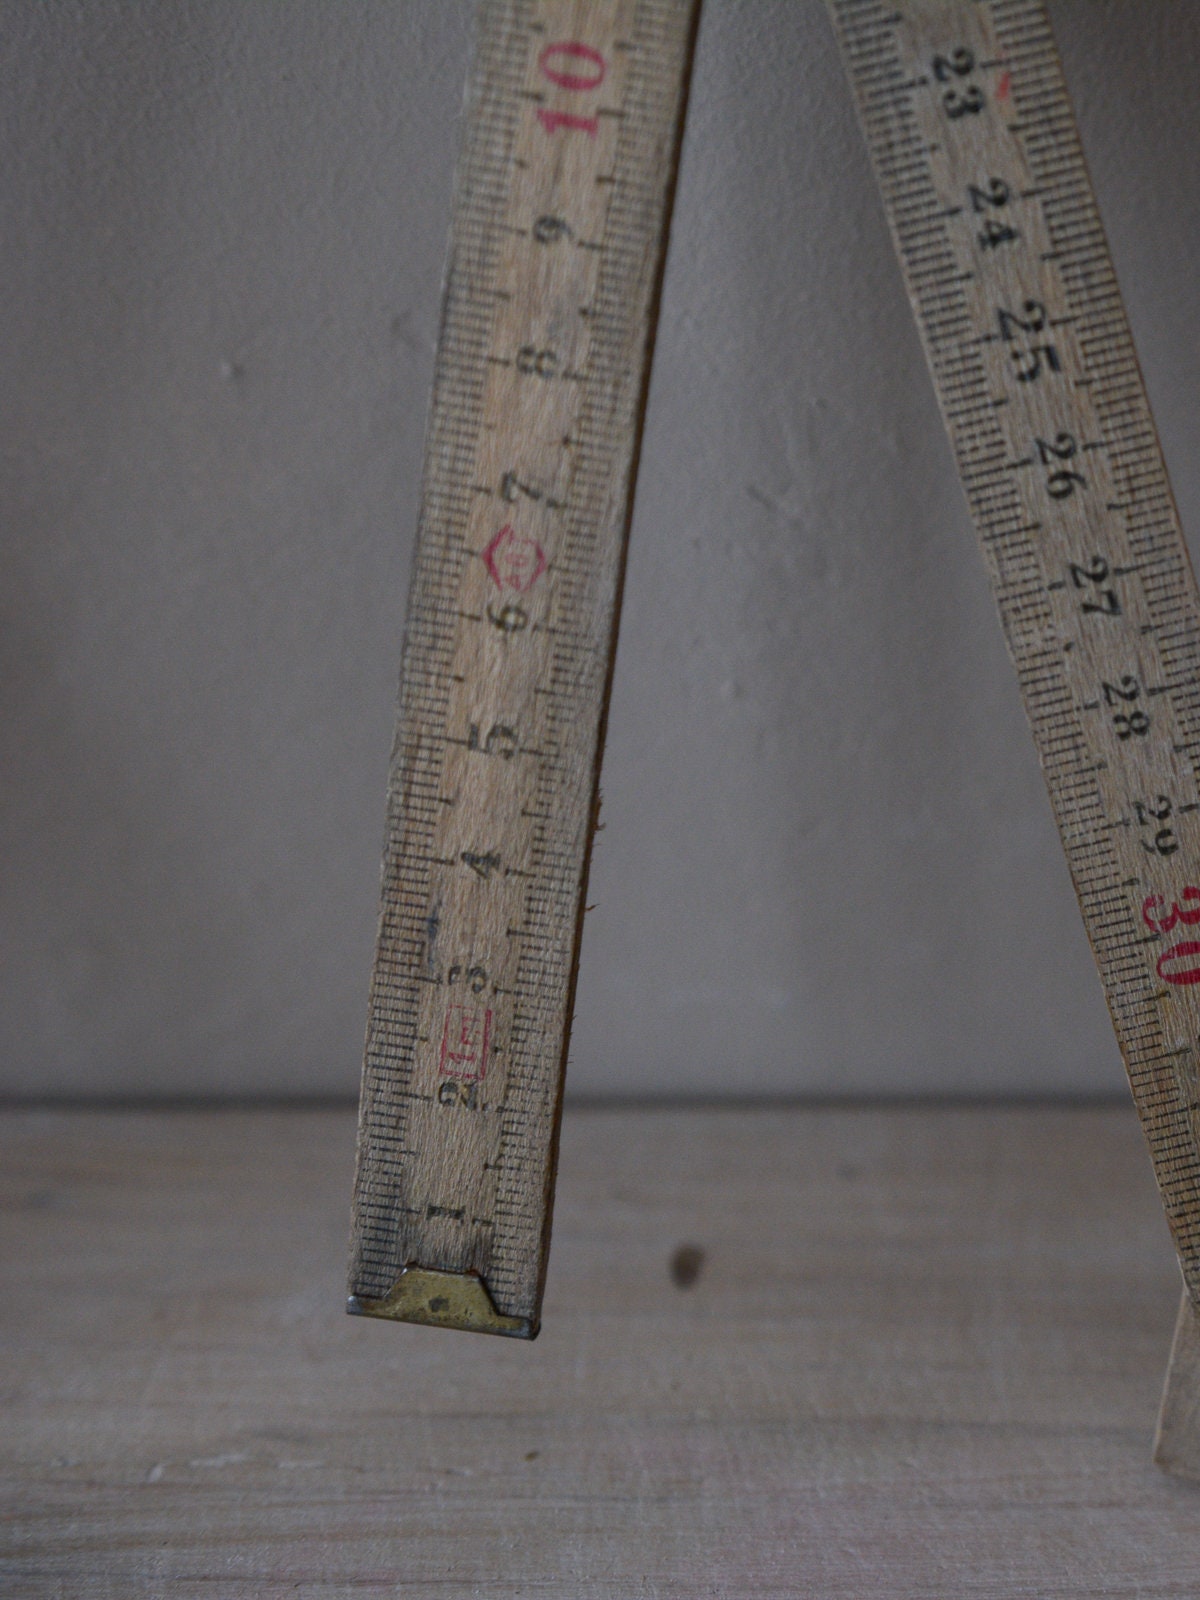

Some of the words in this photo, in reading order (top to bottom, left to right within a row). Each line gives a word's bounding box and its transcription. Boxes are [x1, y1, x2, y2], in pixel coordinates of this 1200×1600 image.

[535, 41, 607, 138] 10
[932, 47, 984, 121] 23
[531, 214, 575, 246] 9
[967, 176, 1020, 251] 24
[998, 300, 1061, 385] 25
[515, 344, 558, 379] 8
[1033, 432, 1088, 500] 26
[500, 470, 542, 505] 7
[1068, 555, 1121, 619] 27
[485, 603, 528, 634] 6
[1103, 674, 1151, 742] 28
[466, 723, 521, 760] 5
[1134, 794, 1180, 858] 29
[459, 849, 503, 881] 4
[448, 965, 489, 994] 3
[437, 1079, 478, 1112] 2
[426, 1204, 466, 1222] 1
